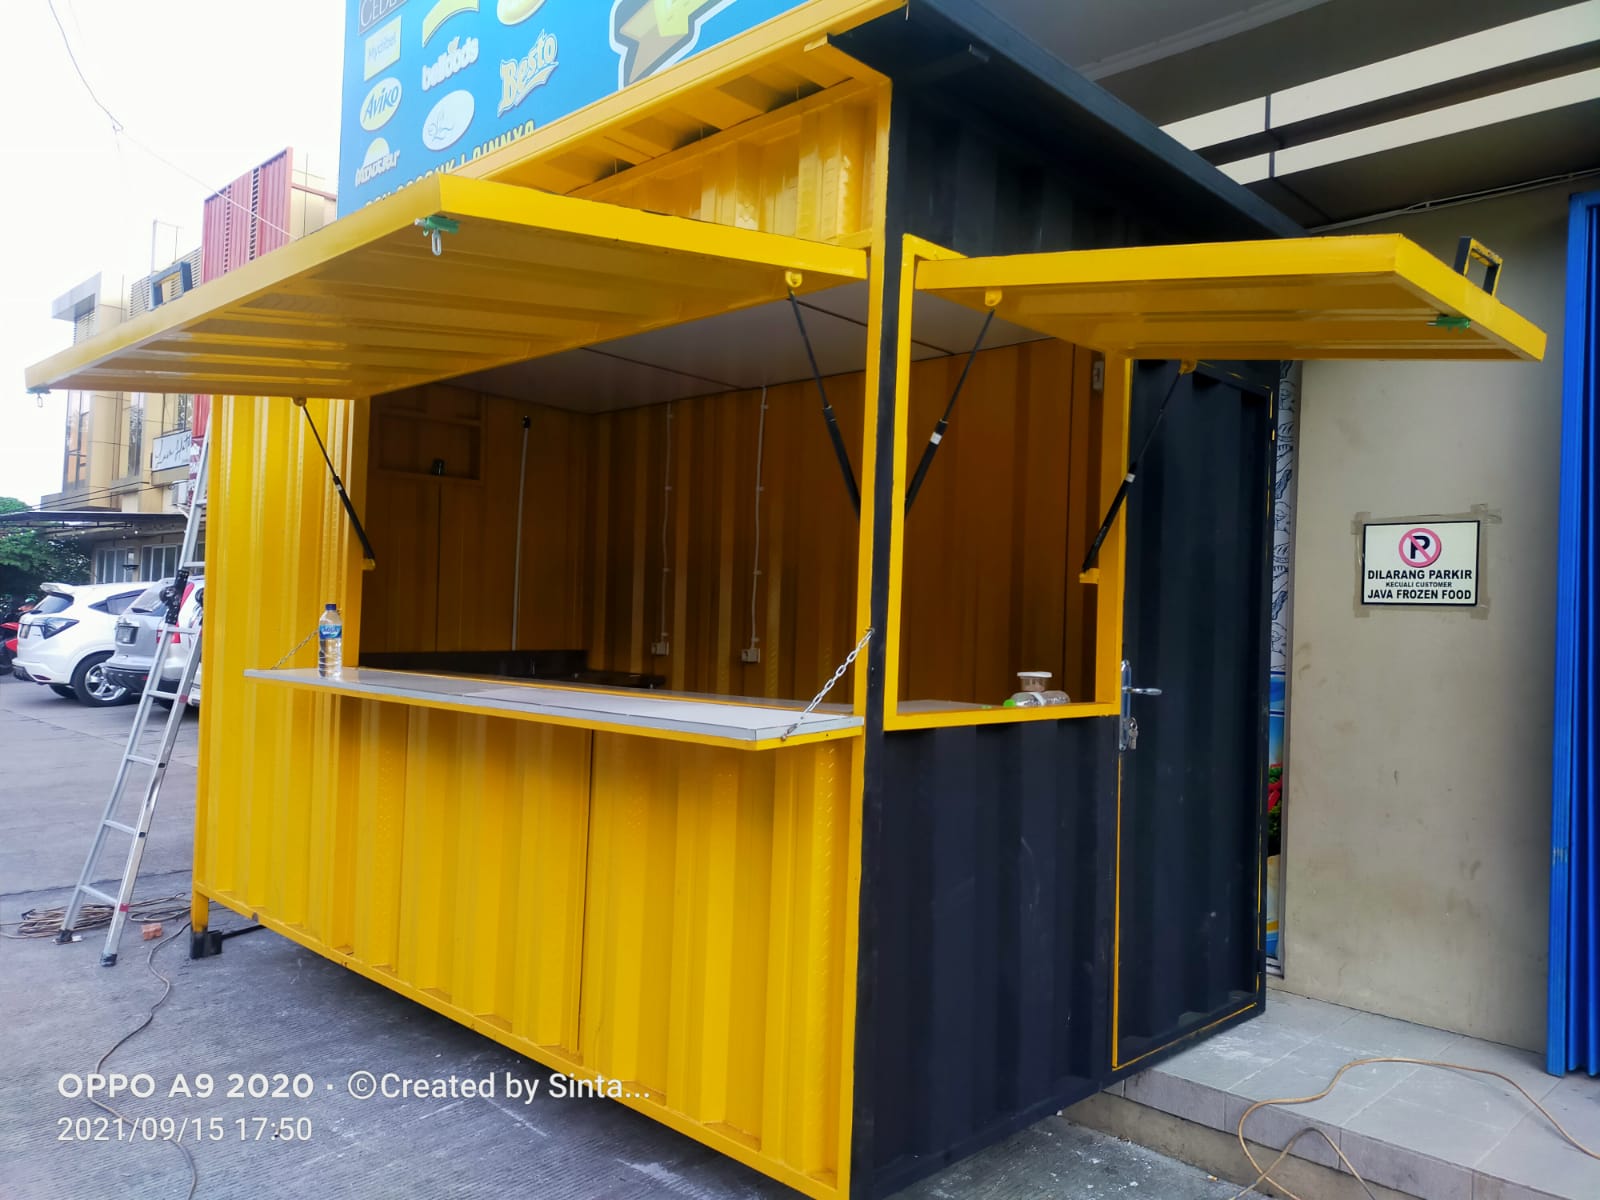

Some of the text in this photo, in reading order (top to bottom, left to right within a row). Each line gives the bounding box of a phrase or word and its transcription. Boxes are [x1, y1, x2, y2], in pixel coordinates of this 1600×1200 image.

[498, 30, 558, 116] Besto
[1367, 570, 1473, 580] DILARANG PARKIR
[1367, 589, 1472, 600] JAVA FROZEN FOOD
